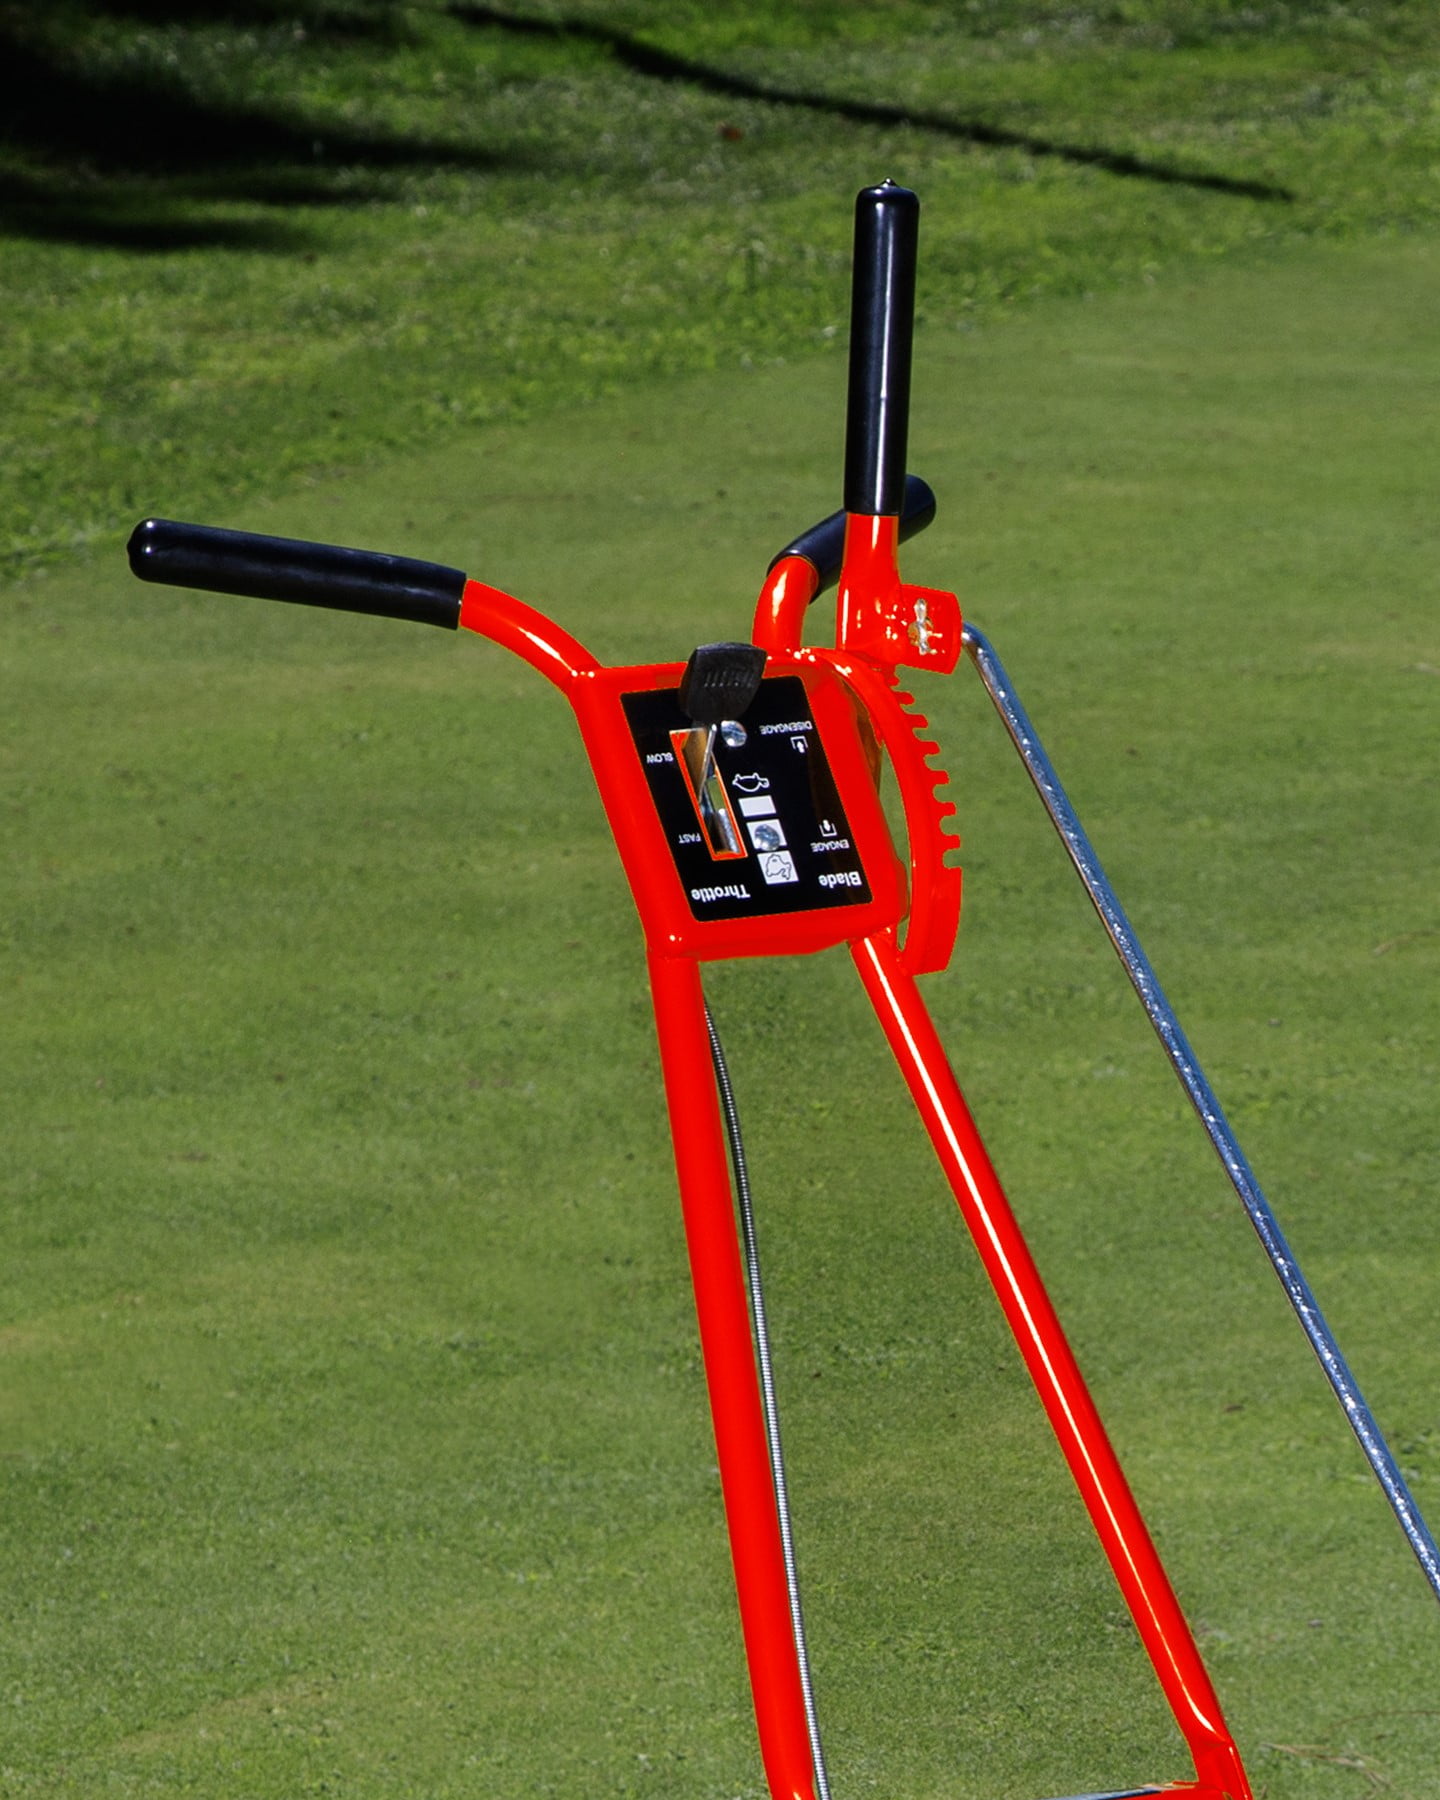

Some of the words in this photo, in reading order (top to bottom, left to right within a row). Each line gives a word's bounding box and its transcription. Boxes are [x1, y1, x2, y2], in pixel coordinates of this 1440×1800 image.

[759, 721, 813, 735] DISENGAGE
[646, 752, 674, 764] SLOW
[678, 833, 702, 844] FAST
[810, 839, 850, 853] ENGAGE
[818, 871, 862, 889] Blade
[691, 884, 751, 902] Throttle
